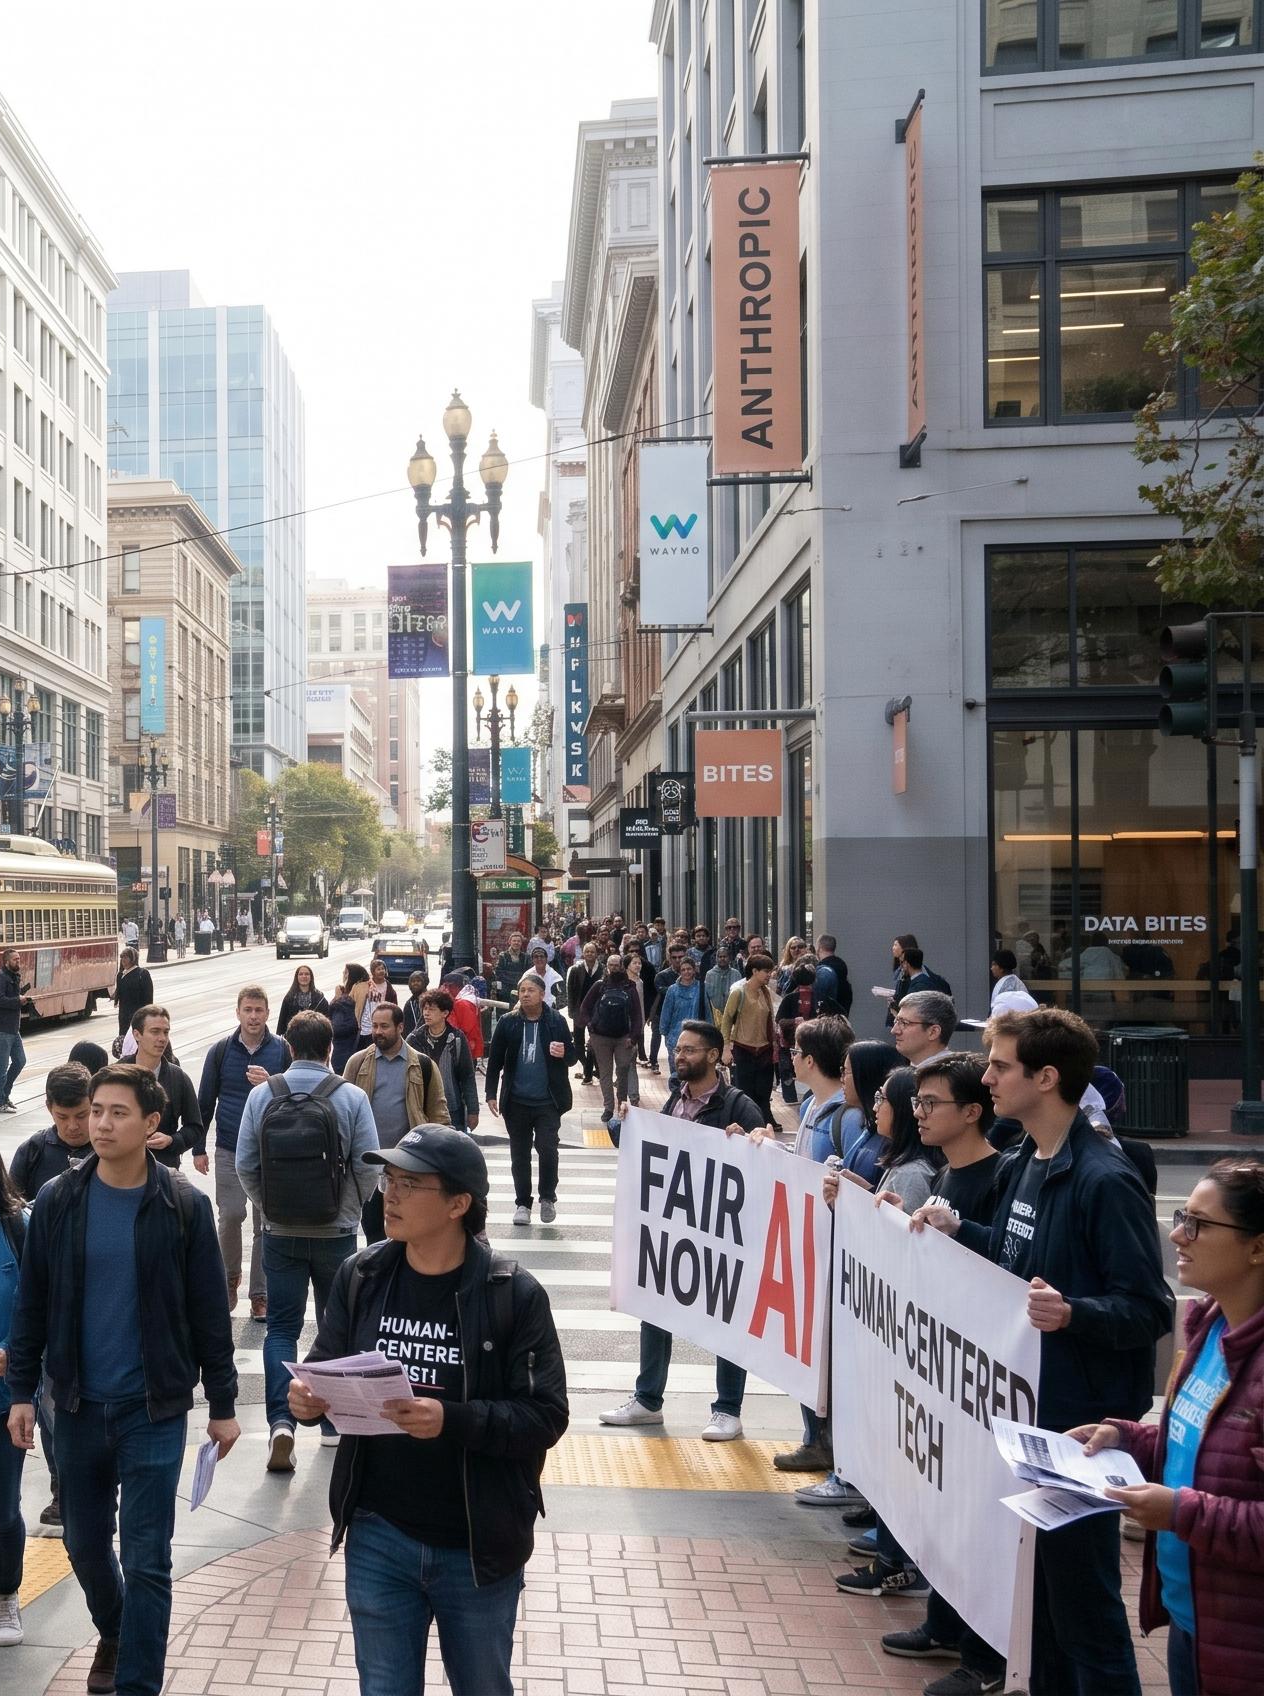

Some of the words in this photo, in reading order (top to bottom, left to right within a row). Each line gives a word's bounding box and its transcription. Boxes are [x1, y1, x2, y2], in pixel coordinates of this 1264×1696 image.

[738, 186, 773, 450] ANTHROPIC
[650, 546, 700, 556] WAYMO
[482, 626, 524, 635] WAYMO
[703, 765, 773, 783] BITES
[1084, 916, 1139, 932] DATA
[1145, 916, 1207, 932] BITES
[640, 1140, 745, 1247] FAIR
[638, 1223, 744, 1324] NOW
[748, 1180, 815, 1368] AI
[376, 1338, 464, 1365] CENTERE
[379, 1316, 454, 1340] HUMAN-
[840, 1248, 1036, 1433] HUMAN-CENTERED
[894, 1379, 943, 1492] TECH
